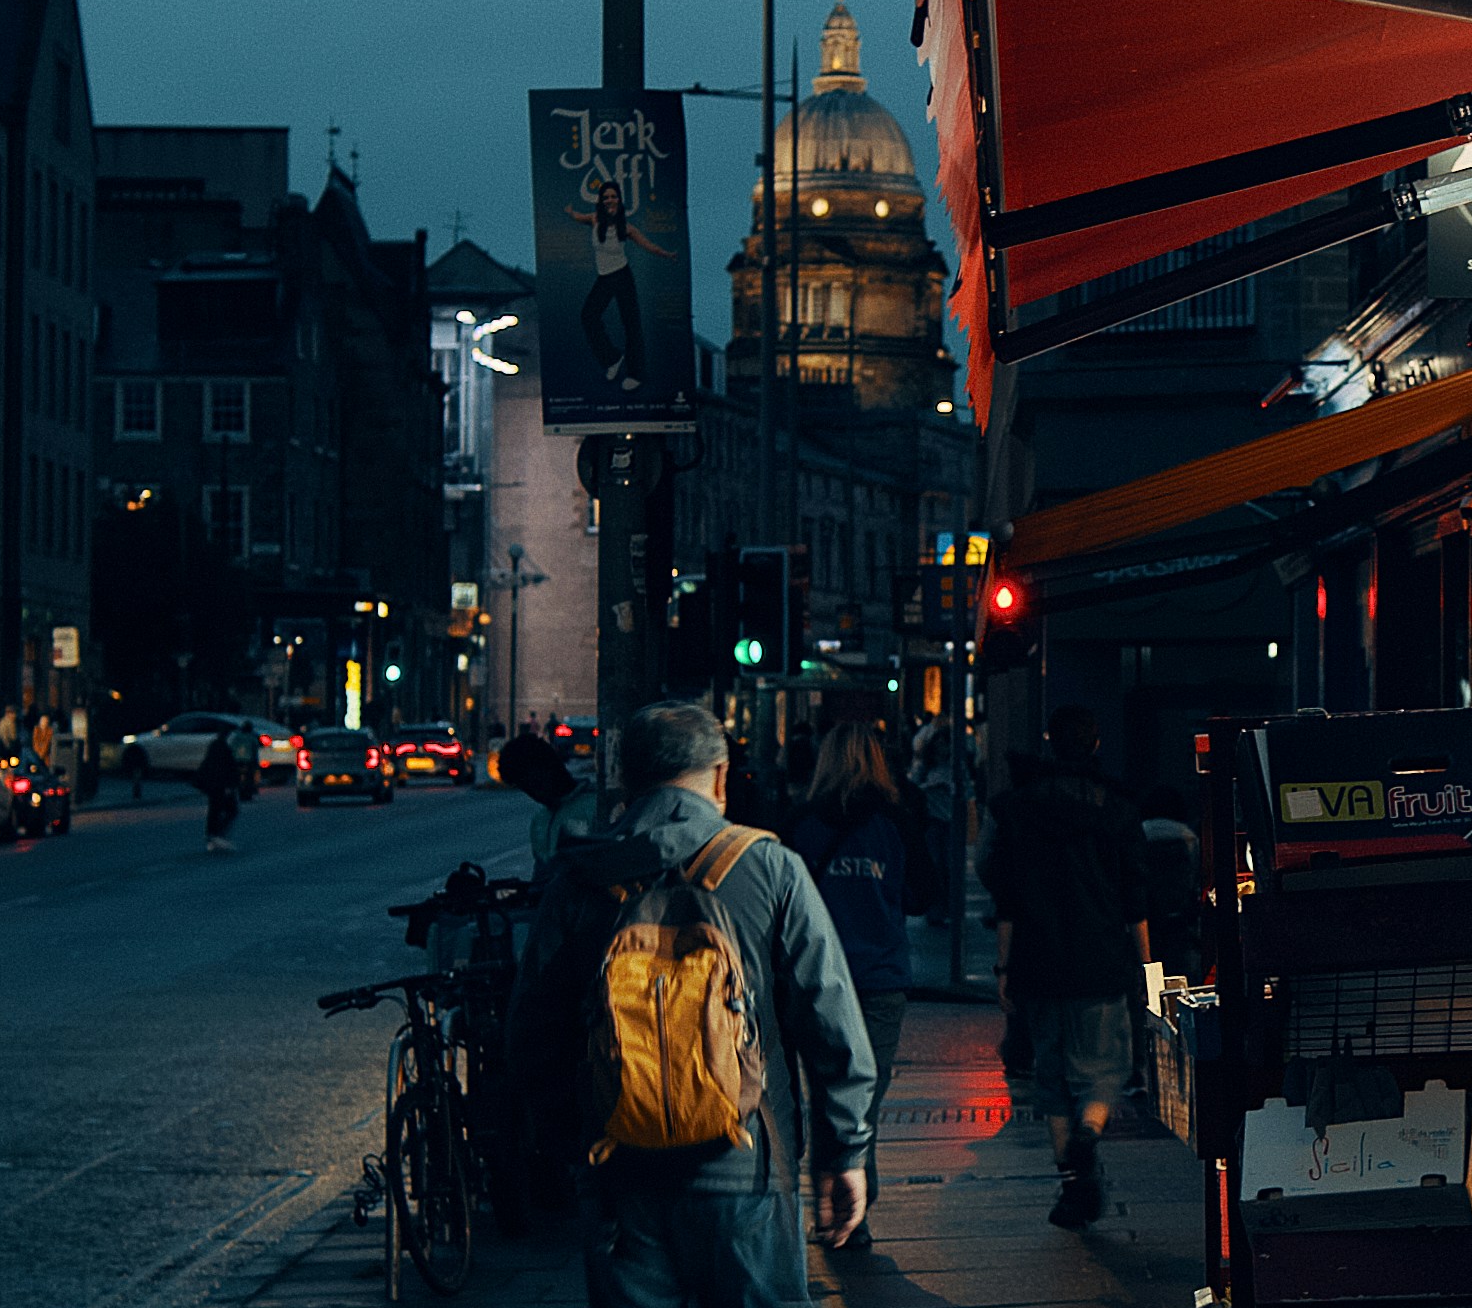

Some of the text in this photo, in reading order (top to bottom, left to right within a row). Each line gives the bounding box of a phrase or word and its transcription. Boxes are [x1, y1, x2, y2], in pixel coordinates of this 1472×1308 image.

[550, 107, 670, 170] Jerk
[1388, 783, 1472, 819] fruit
[1309, 1132, 1396, 1181] Sicilia
